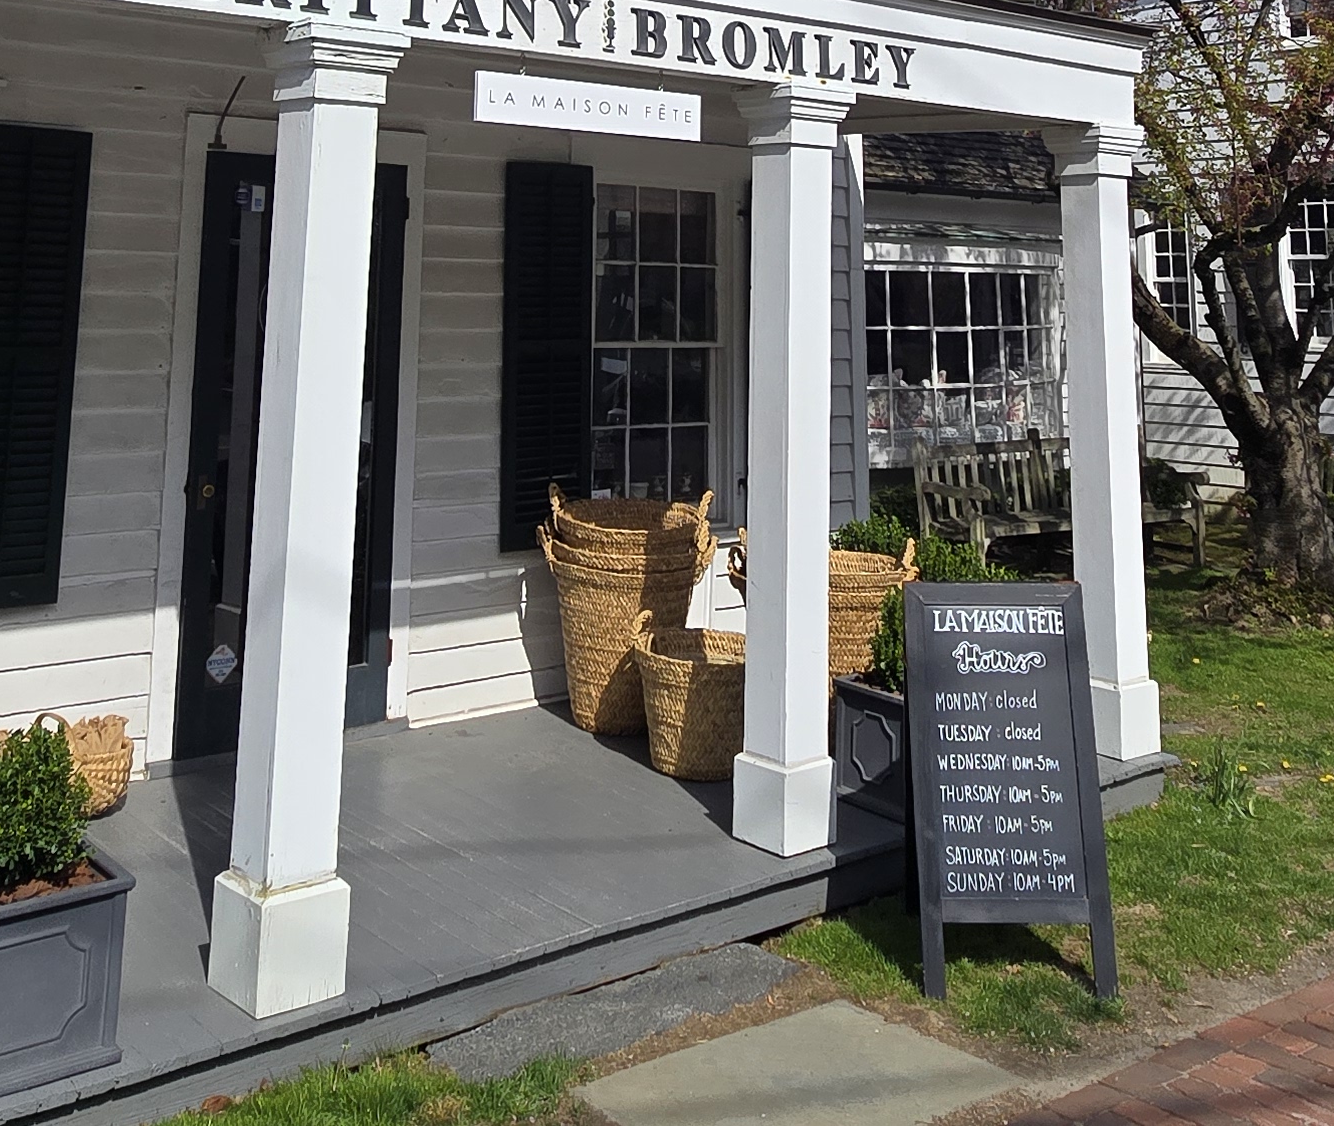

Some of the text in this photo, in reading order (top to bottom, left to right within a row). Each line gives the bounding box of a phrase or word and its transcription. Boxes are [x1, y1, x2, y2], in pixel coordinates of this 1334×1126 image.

[630, 6, 917, 91] BROMLEY
[488, 89, 693, 124] LA MAISON FÊTE
[932, 606, 1065, 635] LA MAISON FÊTE
[952, 640, 1047, 674] Hours
[995, 689, 1038, 710] closed
[1004, 721, 1042, 741] closed
